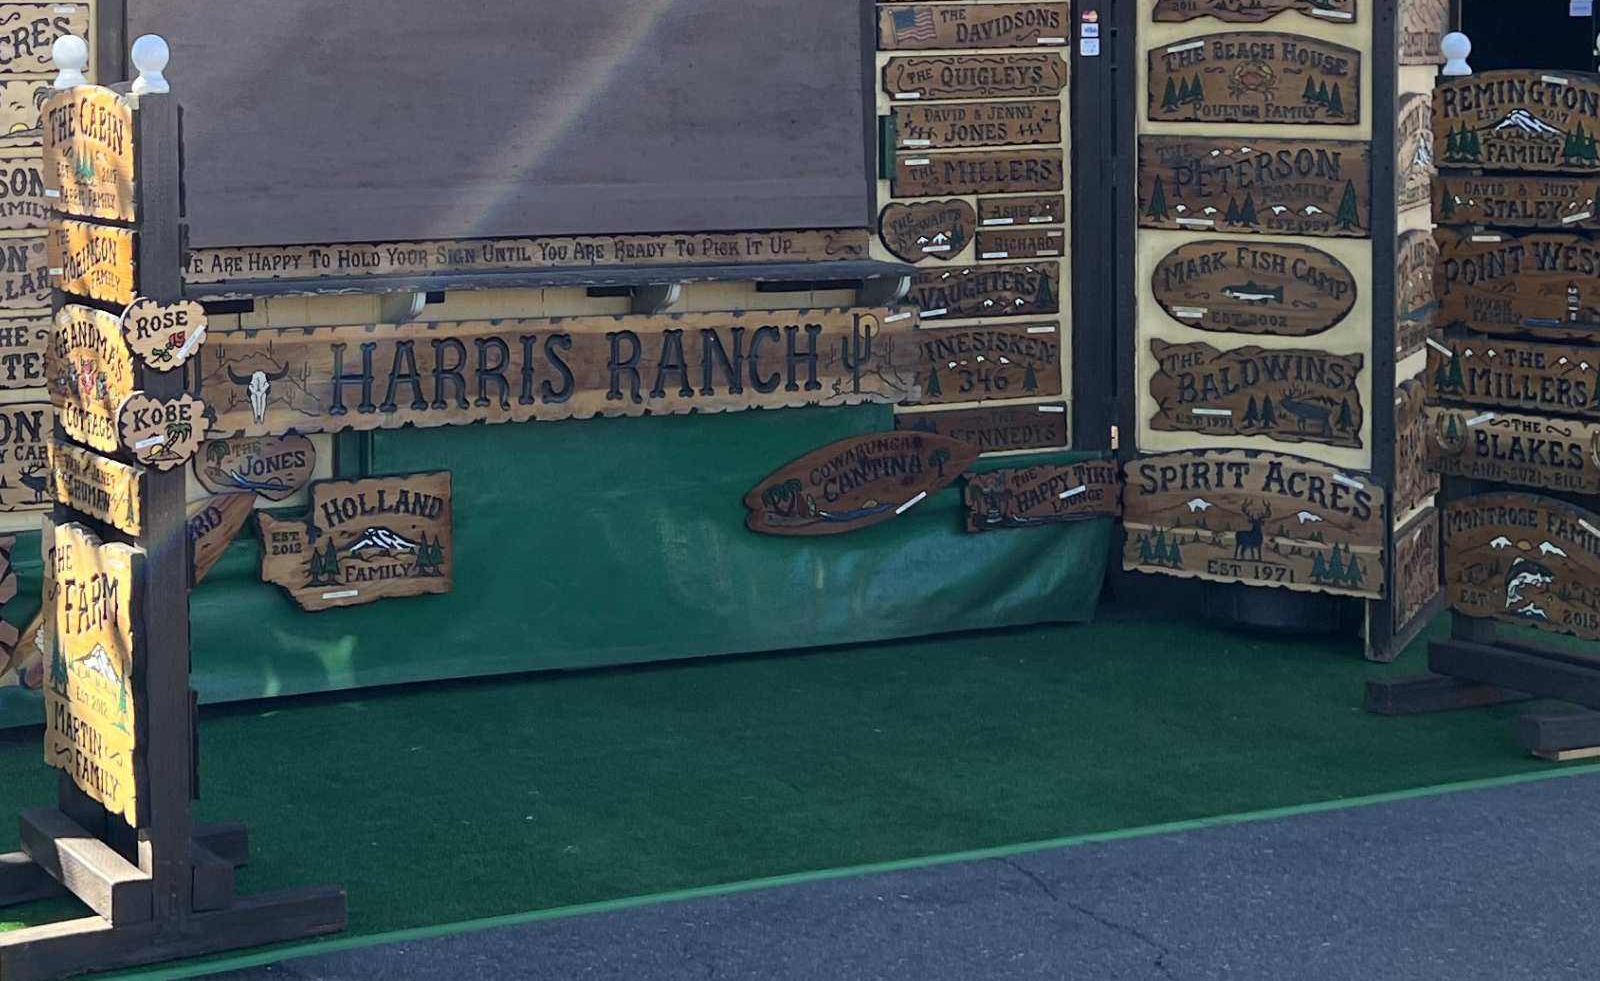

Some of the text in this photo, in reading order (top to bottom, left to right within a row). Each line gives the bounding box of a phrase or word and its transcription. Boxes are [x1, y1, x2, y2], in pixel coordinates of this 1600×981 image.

[940, 8, 1060, 43] THE DAVIDSONS
[1212, 41, 1349, 78] BEACH HOUSE
[907, 66, 1043, 87] THE QUIGLEYS
[1264, 103, 1320, 119] FAMILY
[1441, 79, 1599, 119] REMINGTON
[924, 106, 1037, 122] DAVID JENNY
[1541, 109, 1569, 123] 2017
[944, 123, 1008, 142] JONES
[1487, 143, 1561, 164] FAMILY
[909, 159, 1051, 185] THE MILLERS
[1172, 148, 1341, 199] PETERSON
[1258, 183, 1335, 205] FAMILY
[1464, 182, 1579, 197] DAVID JUDY
[1484, 198, 1563, 219] STALEY
[249, 241, 667, 272] HAPPY TO HOLD YOUR SIGN UNTIL YOU READY
[1443, 246, 1524, 294] POINT
[1163, 246, 1349, 301] MARK FISH CAMP
[136, 310, 188, 340] ROSE
[329, 324, 822, 416] HARRIS RANCH
[1166, 351, 1205, 371] THE
[1505, 349, 1546, 369] THE
[1176, 354, 1346, 405] BALDWINS
[1468, 368, 1587, 408] MILLERS
[133, 404, 192, 432] KOBE
[1512, 419, 1541, 433] THE
[1474, 429, 1584, 468] BLAKES
[238, 451, 306, 477] JONES
[1139, 461, 1373, 523] SPIRIT ACRES
[320, 489, 444, 529] HOLLAND
[345, 563, 415, 583] FAMILY
[1253, 566, 1295, 583] 1971
[65, 573, 118, 634] FARM
